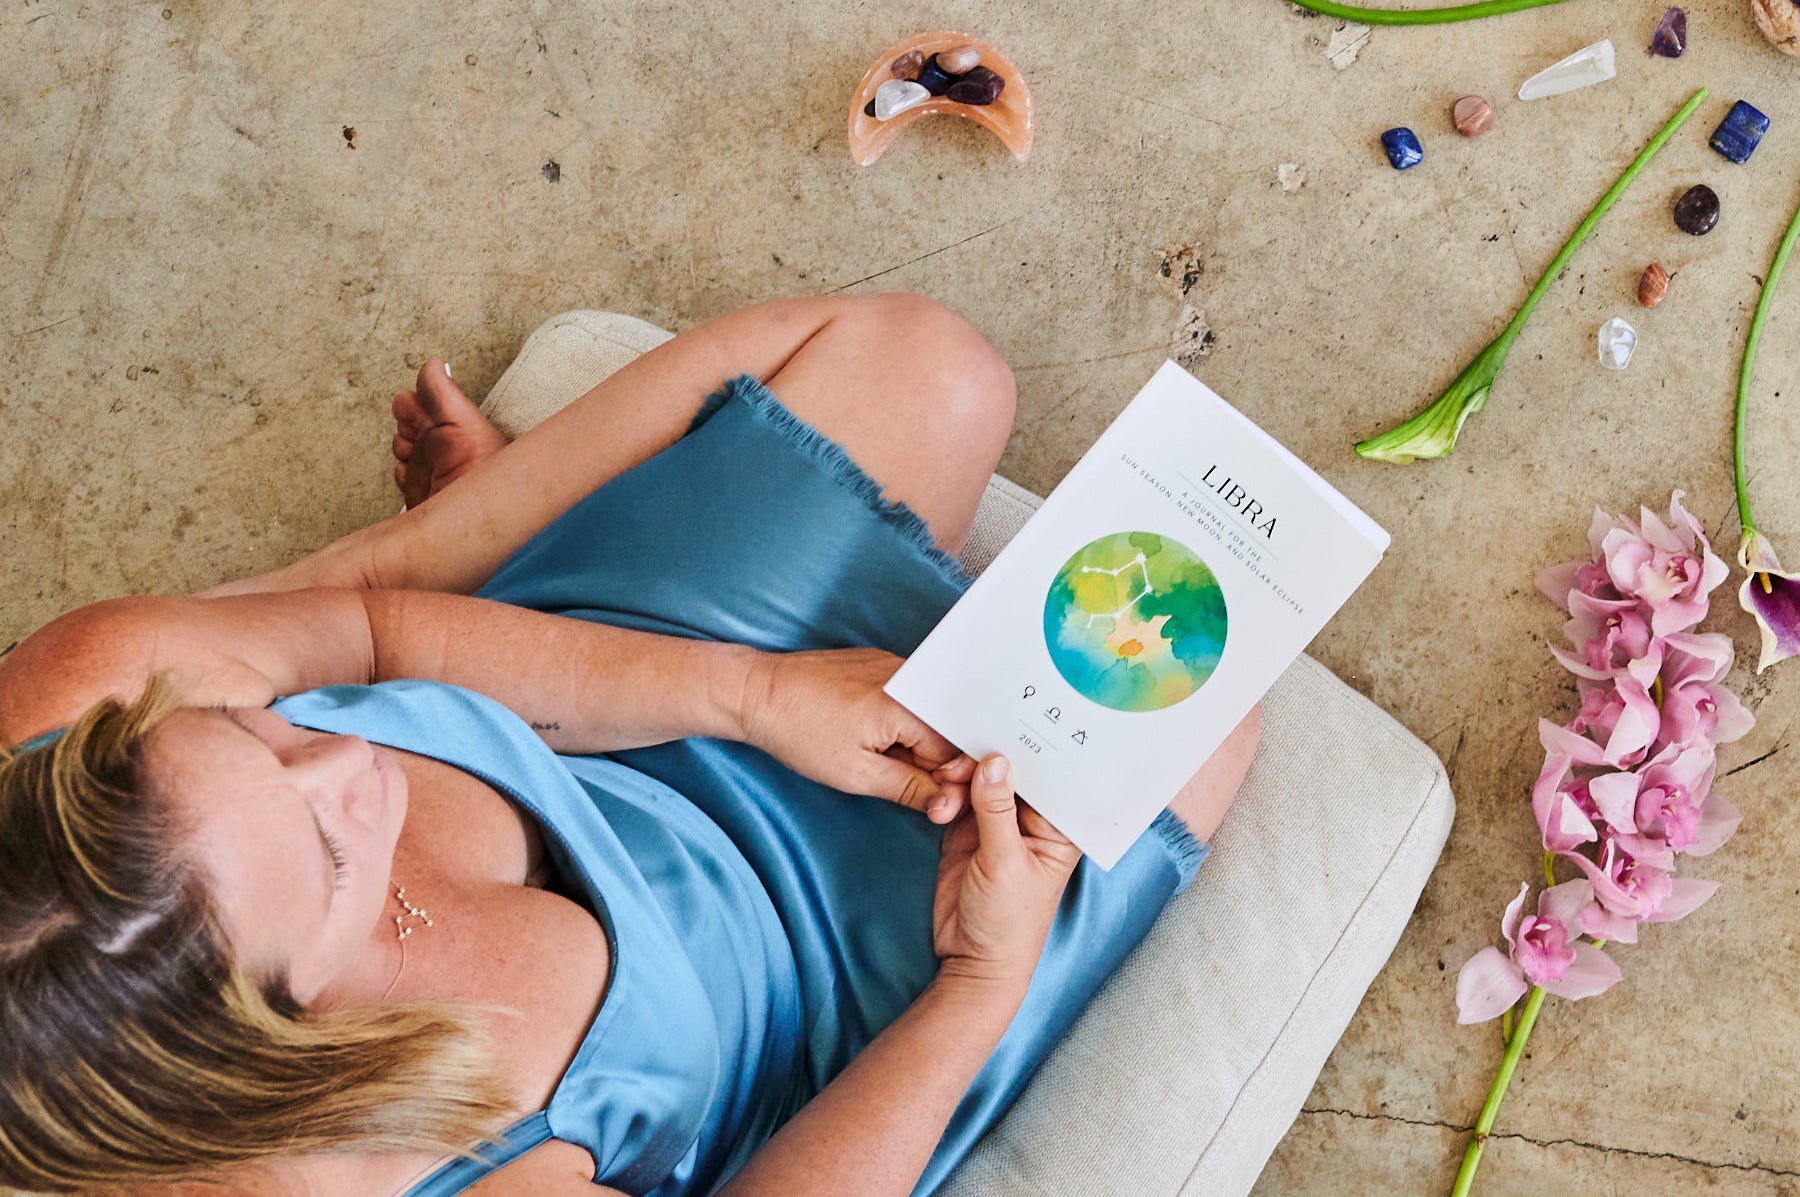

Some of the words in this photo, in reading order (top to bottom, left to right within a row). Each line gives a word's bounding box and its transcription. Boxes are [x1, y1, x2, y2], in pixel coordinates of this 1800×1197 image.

[1121, 453, 1138, 470] SUN
[1176, 501, 1195, 518] NEW
[1226, 544, 1244, 561] AND
[1245, 560, 1271, 585] SOLAR
[1272, 584, 1304, 615] ECLIPSE
[1190, 497, 1226, 531] JOURNAL
[1228, 531, 1245, 547] FOR
[1246, 547, 1263, 563] THE
[1202, 465, 1277, 539] LIBRA
[1019, 733, 1041, 753] 2023
